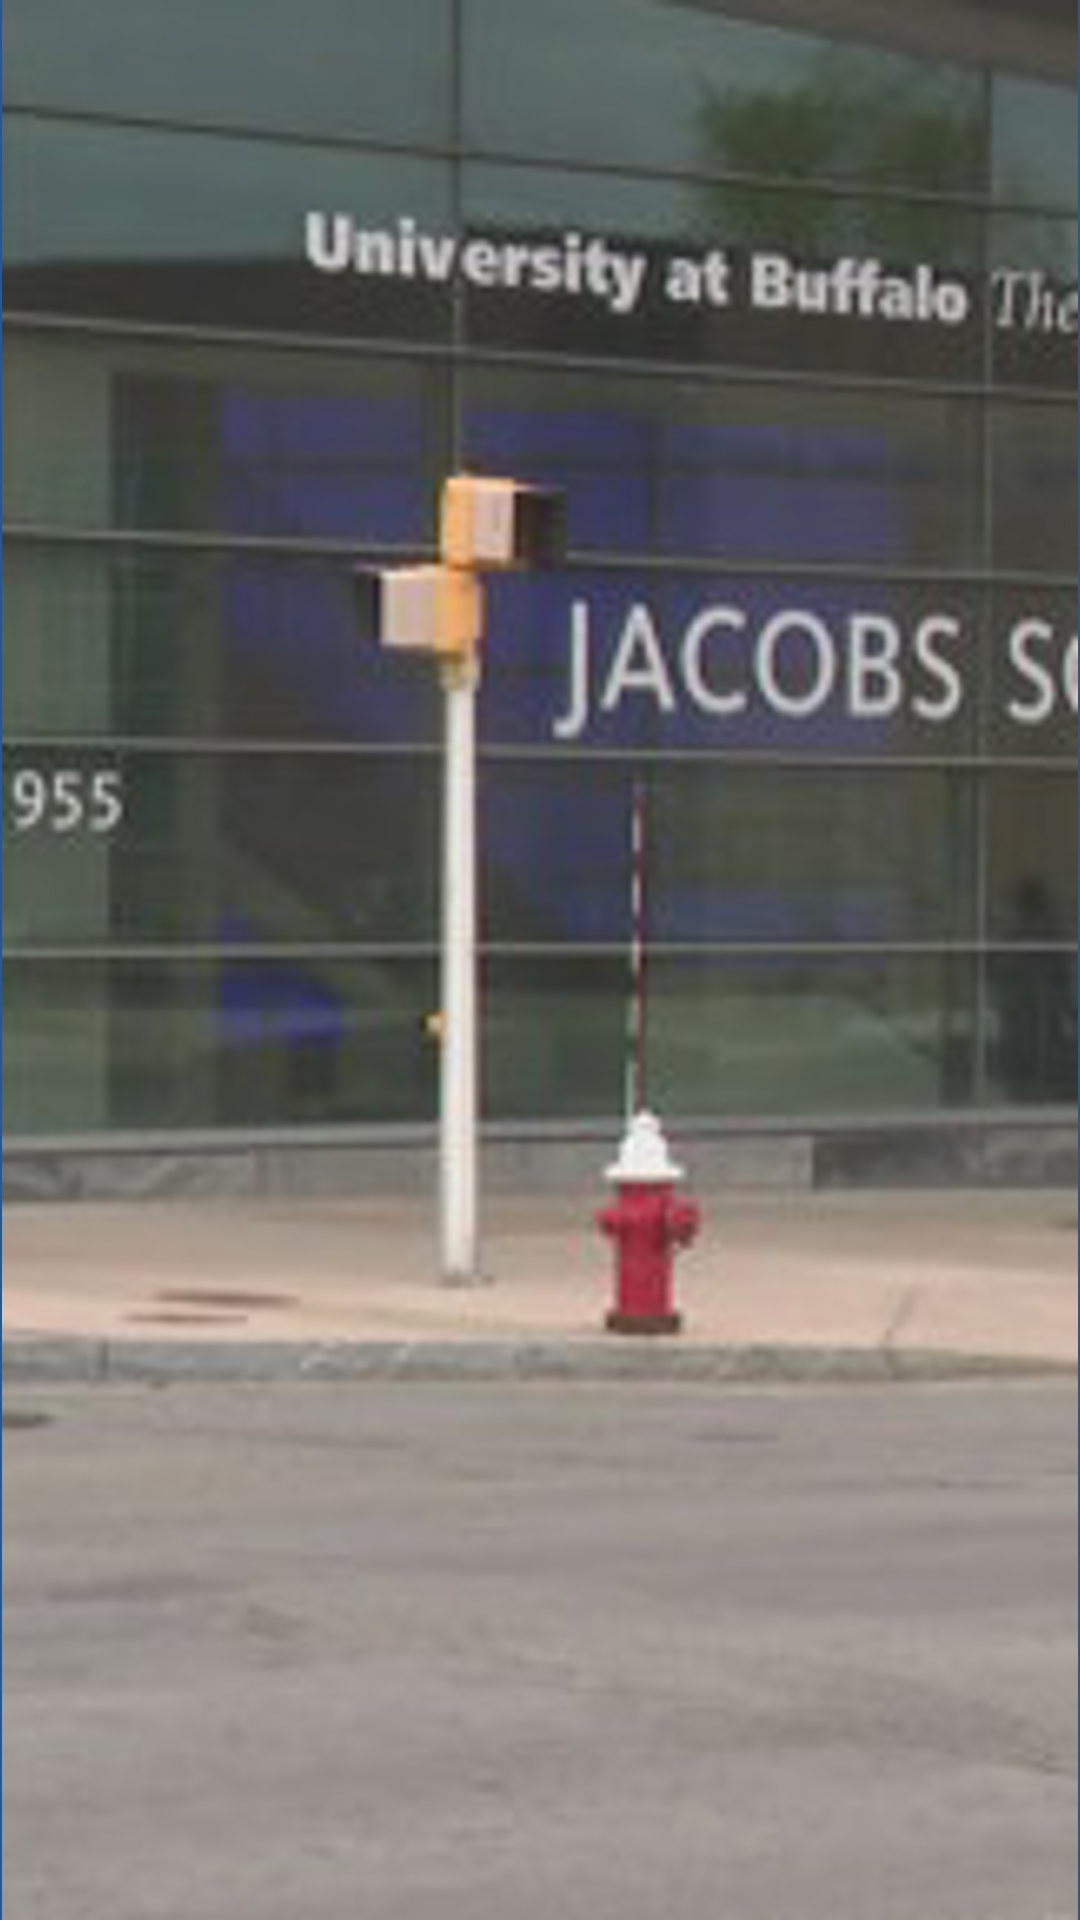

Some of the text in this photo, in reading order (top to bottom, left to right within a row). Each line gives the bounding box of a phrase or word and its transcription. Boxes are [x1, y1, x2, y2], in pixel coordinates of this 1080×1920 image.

[305, 211, 647, 313] University
[665, 251, 730, 305] at
[749, 252, 967, 323] Buffalo
[553, 600, 1078, 738] JACOBS S
[12, 769, 123, 832] 955
